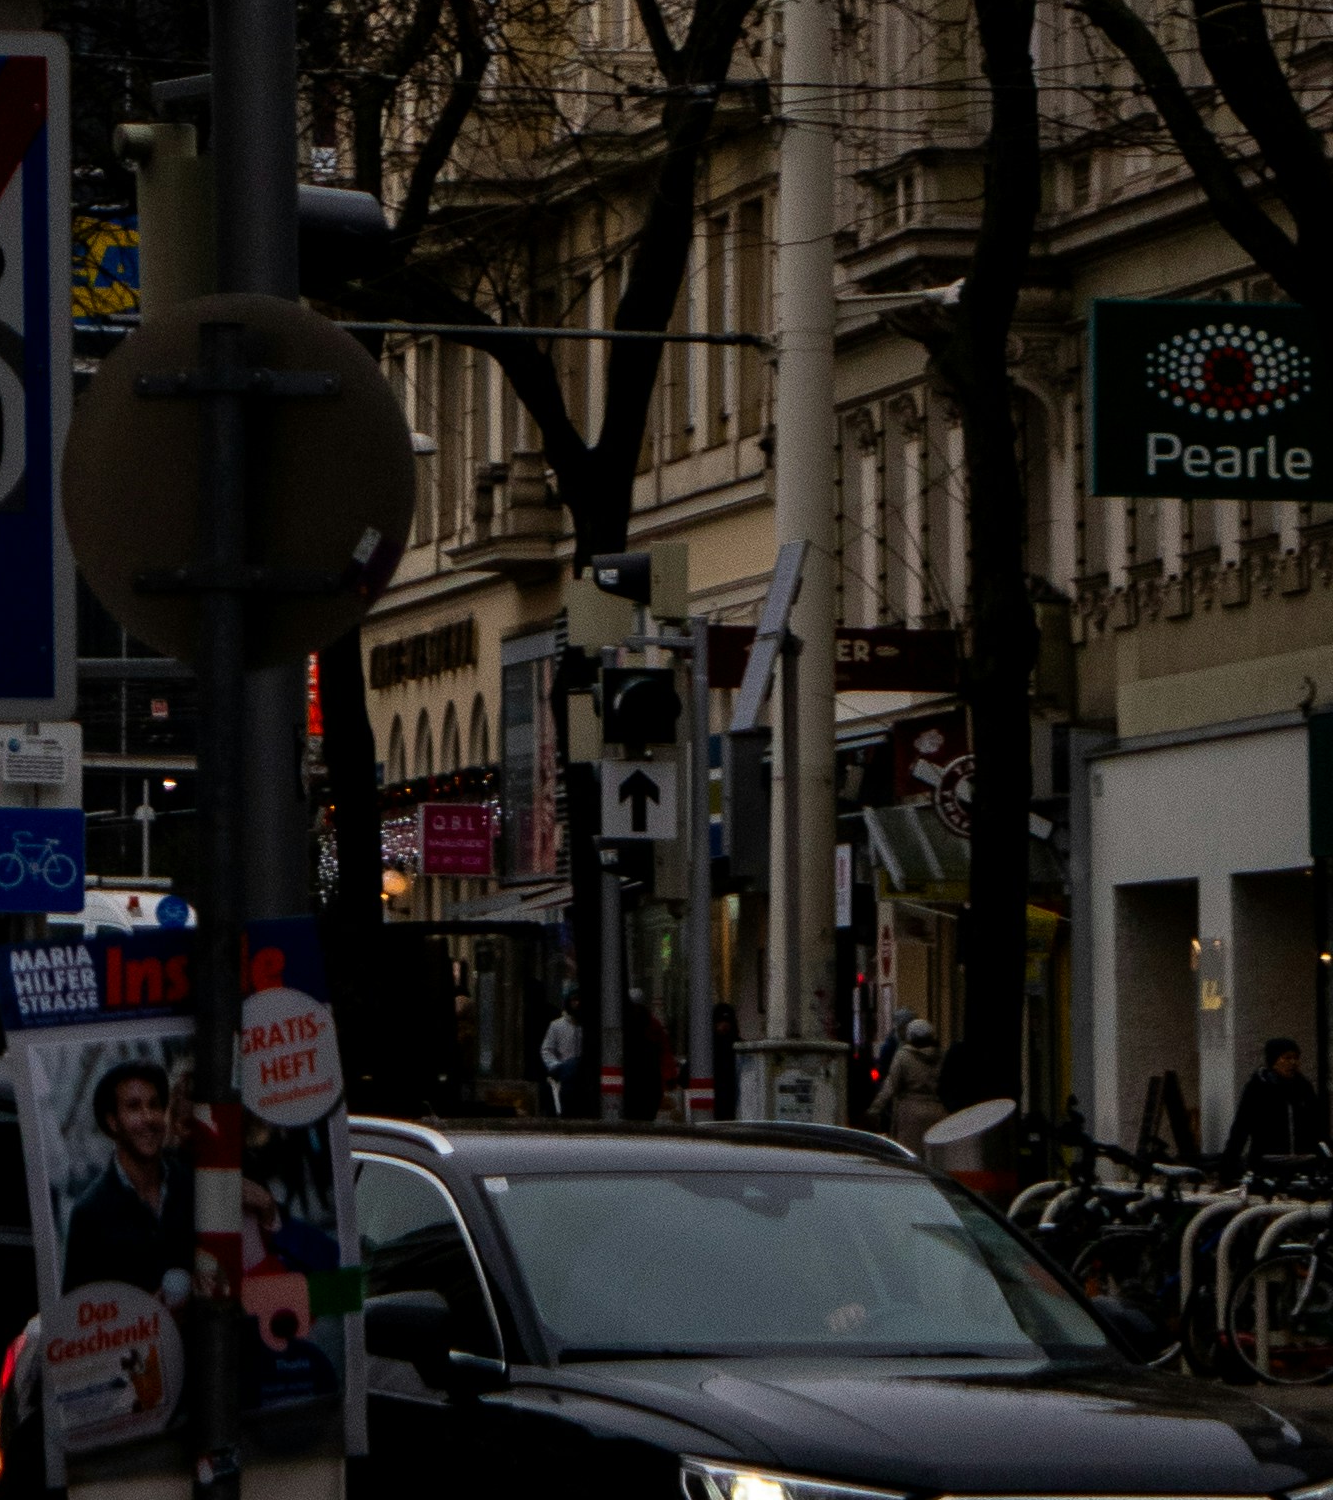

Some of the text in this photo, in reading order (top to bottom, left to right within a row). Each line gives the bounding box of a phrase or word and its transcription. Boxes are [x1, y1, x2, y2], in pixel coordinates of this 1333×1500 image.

[1146, 431, 1314, 481] Pearle
[9, 943, 94, 972] MARIA
[14, 967, 98, 993] HILFER
[18, 990, 101, 1015] STRASSE
[259, 1047, 318, 1085] HEFT
[77, 1300, 118, 1328] Das
[46, 1312, 159, 1364] Geschenk!
